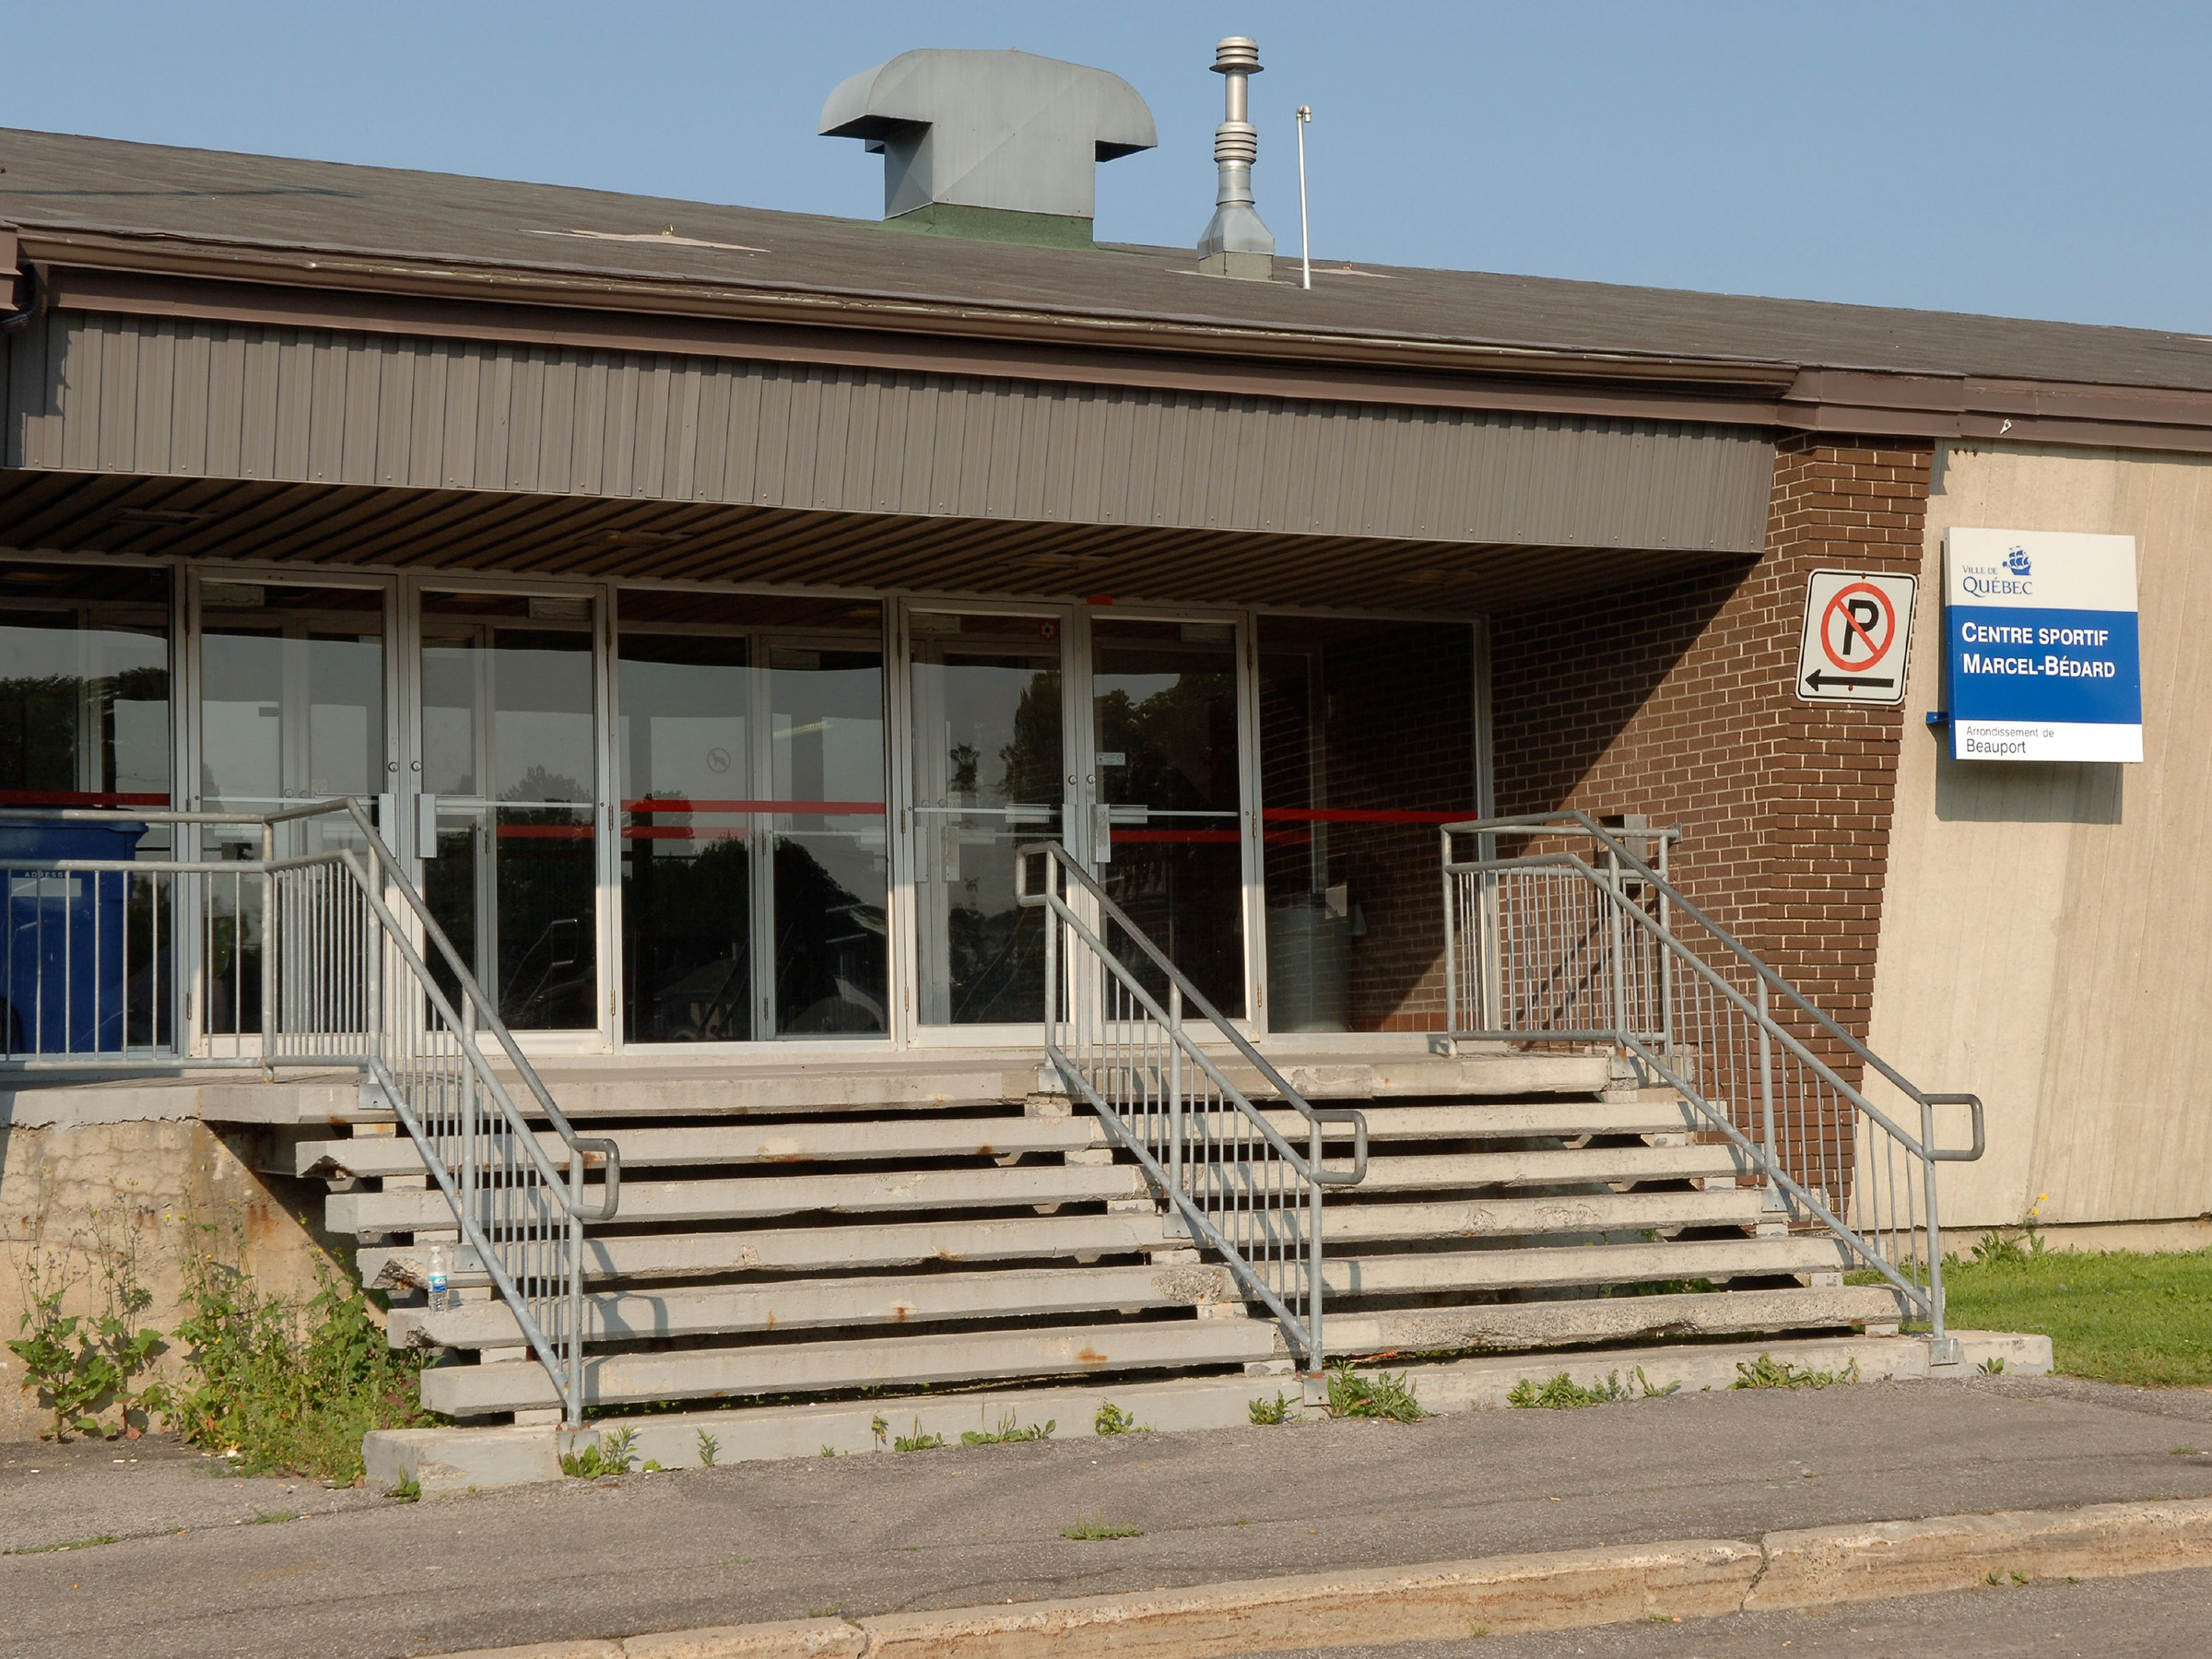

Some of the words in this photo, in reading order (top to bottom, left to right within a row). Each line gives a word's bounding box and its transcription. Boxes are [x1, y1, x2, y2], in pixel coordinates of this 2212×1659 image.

[1962, 565, 1985, 574] VILLE
[1963, 576, 2033, 597] QUÉBEC
[1842, 598, 1879, 655] P
[1961, 621, 2033, 644] CENTRE
[2038, 628, 2109, 646] SPORTIF
[1963, 653, 2115, 677] MARCEL-BÉDARD
[1966, 726, 2039, 737] Arrondissement
[2042, 728, 2054, 737] de
[1966, 738, 2026, 756] Beauport
